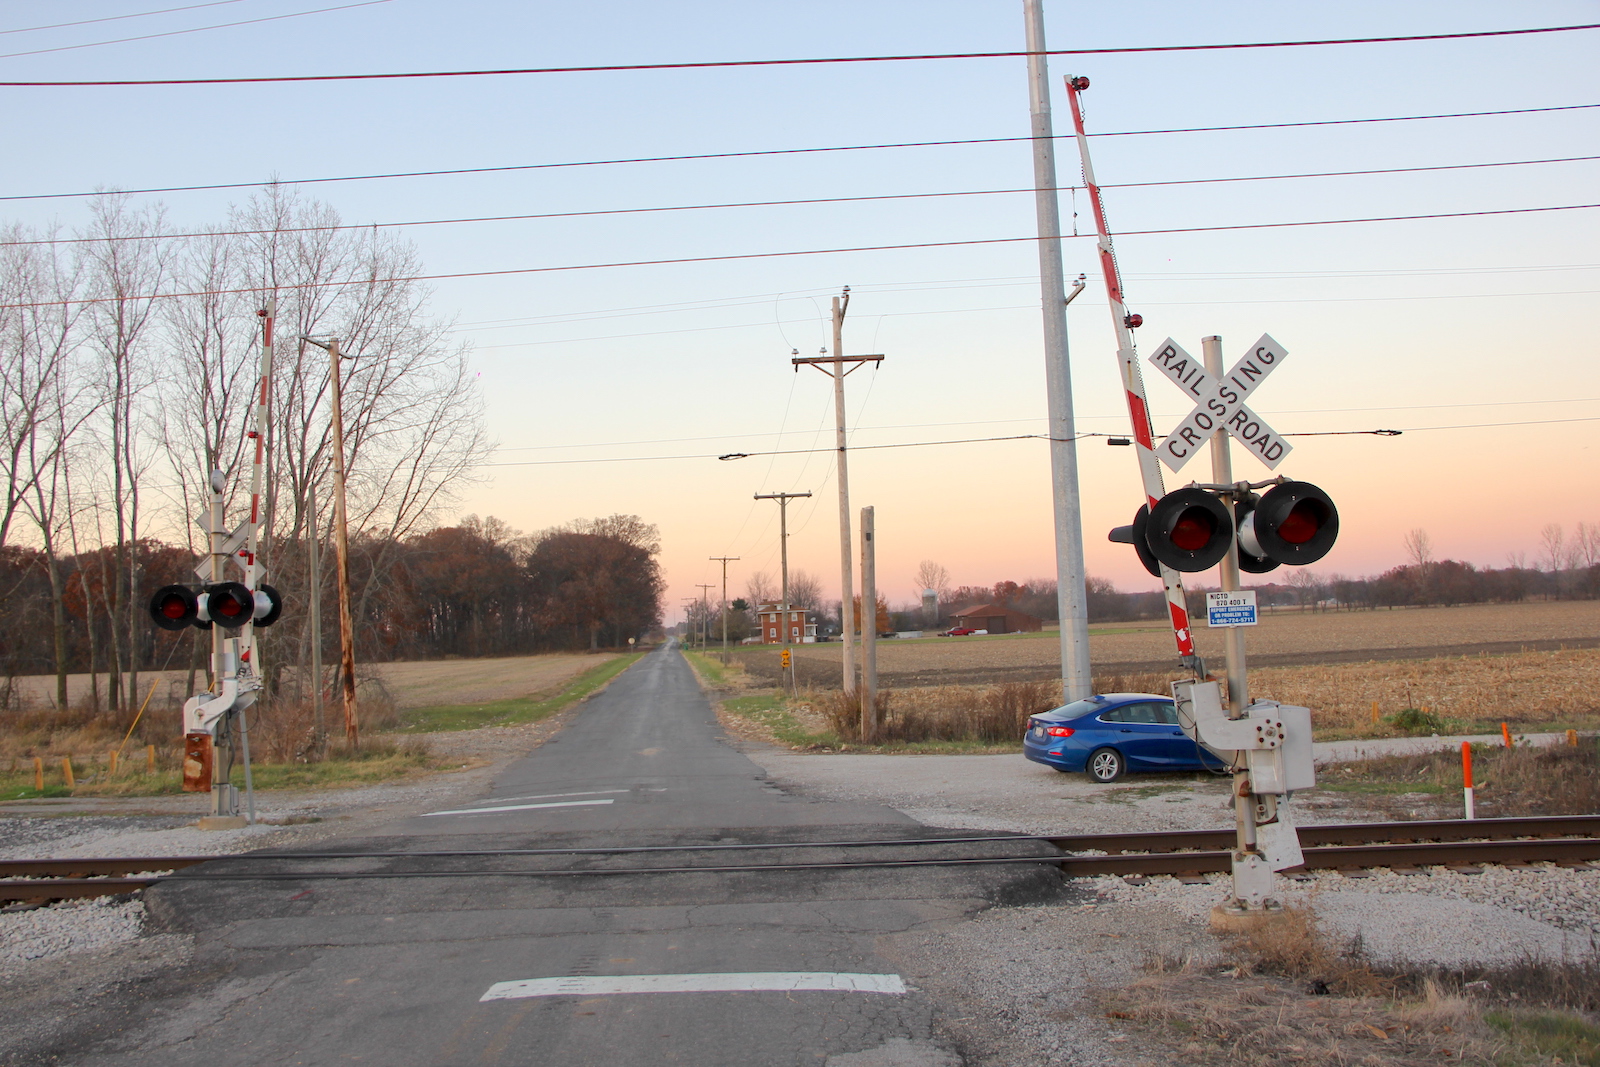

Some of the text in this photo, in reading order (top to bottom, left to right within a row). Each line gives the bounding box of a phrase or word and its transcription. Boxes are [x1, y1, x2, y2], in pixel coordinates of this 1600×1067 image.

[1156, 344, 1284, 461] RAIL ROAD
[1168, 346, 1275, 459] CROSSING
